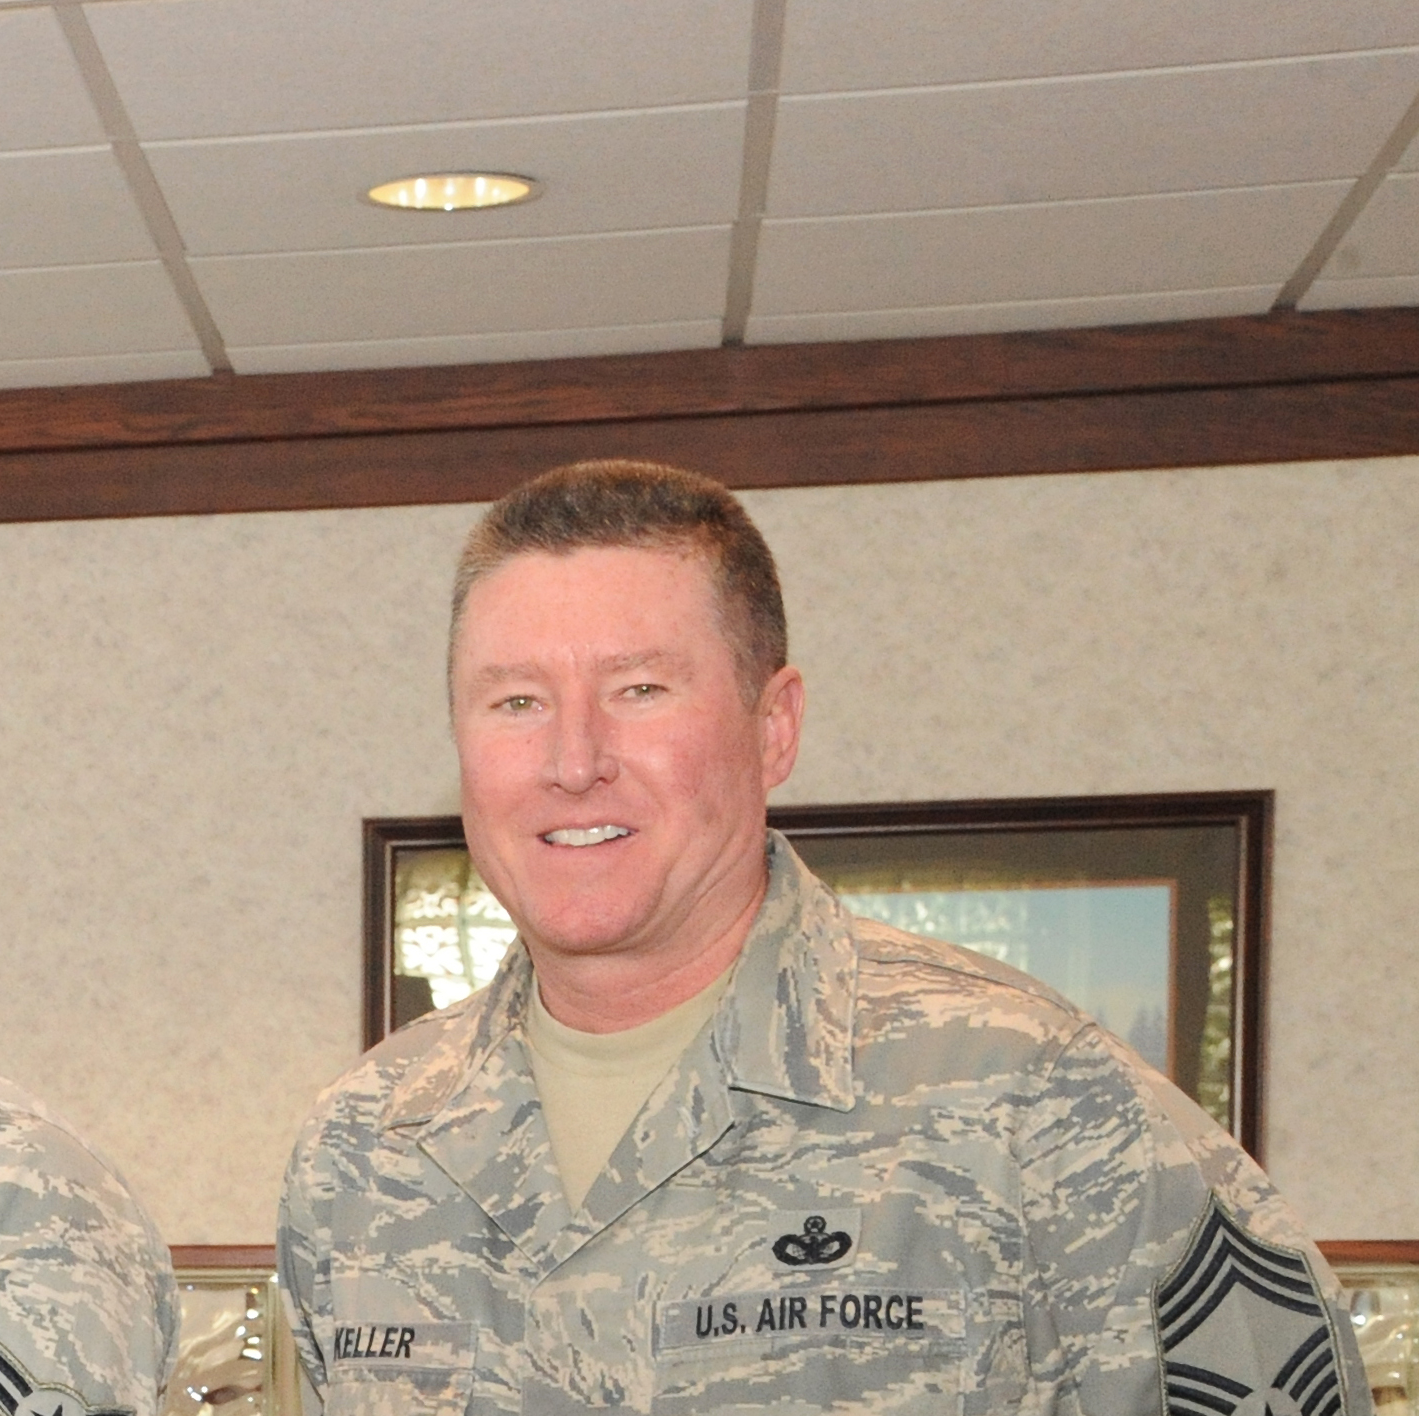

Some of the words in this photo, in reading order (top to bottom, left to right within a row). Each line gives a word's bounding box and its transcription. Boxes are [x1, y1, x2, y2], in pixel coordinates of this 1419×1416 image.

[695, 1302, 746, 1339] U.S.
[756, 1296, 806, 1334] AIR
[819, 1293, 925, 1332] FORCE
[333, 1326, 415, 1361] KELLER
